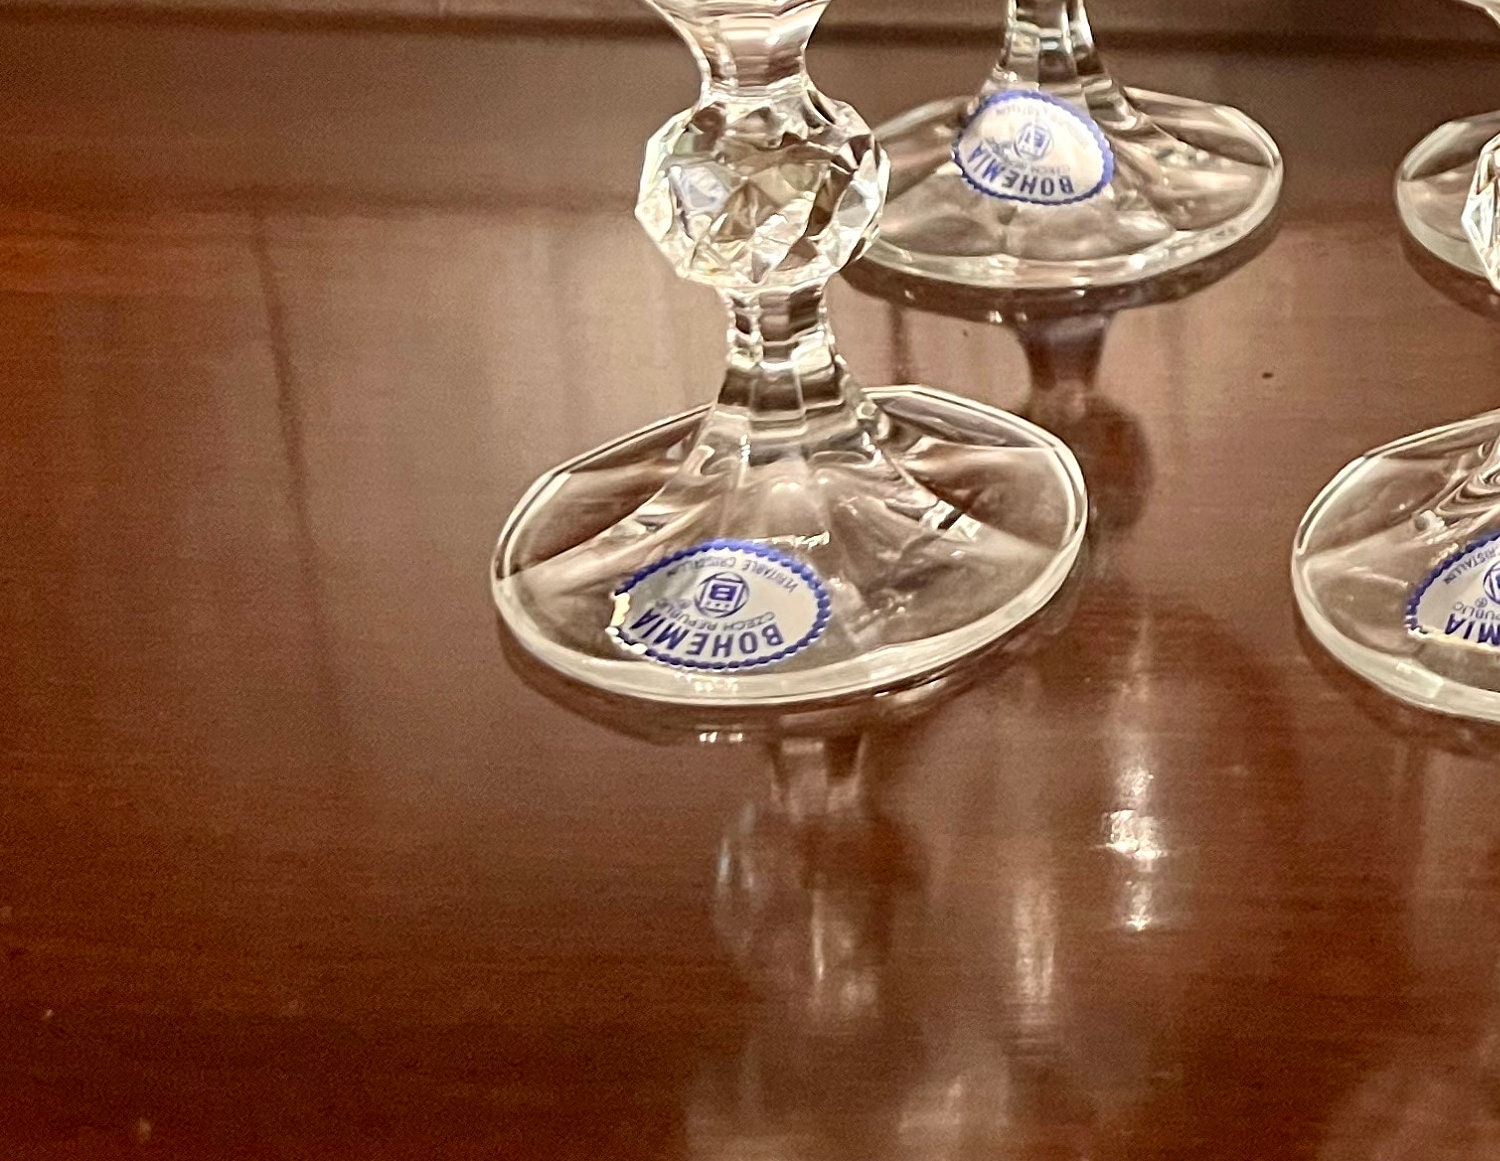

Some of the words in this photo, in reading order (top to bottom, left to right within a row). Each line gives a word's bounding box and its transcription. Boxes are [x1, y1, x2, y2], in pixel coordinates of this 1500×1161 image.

[968, 143, 1074, 196] BOHEMIA
[743, 559, 799, 593] VERITABLE
[631, 608, 784, 658] BOHEMIA
[723, 611, 776, 631] CZECH
